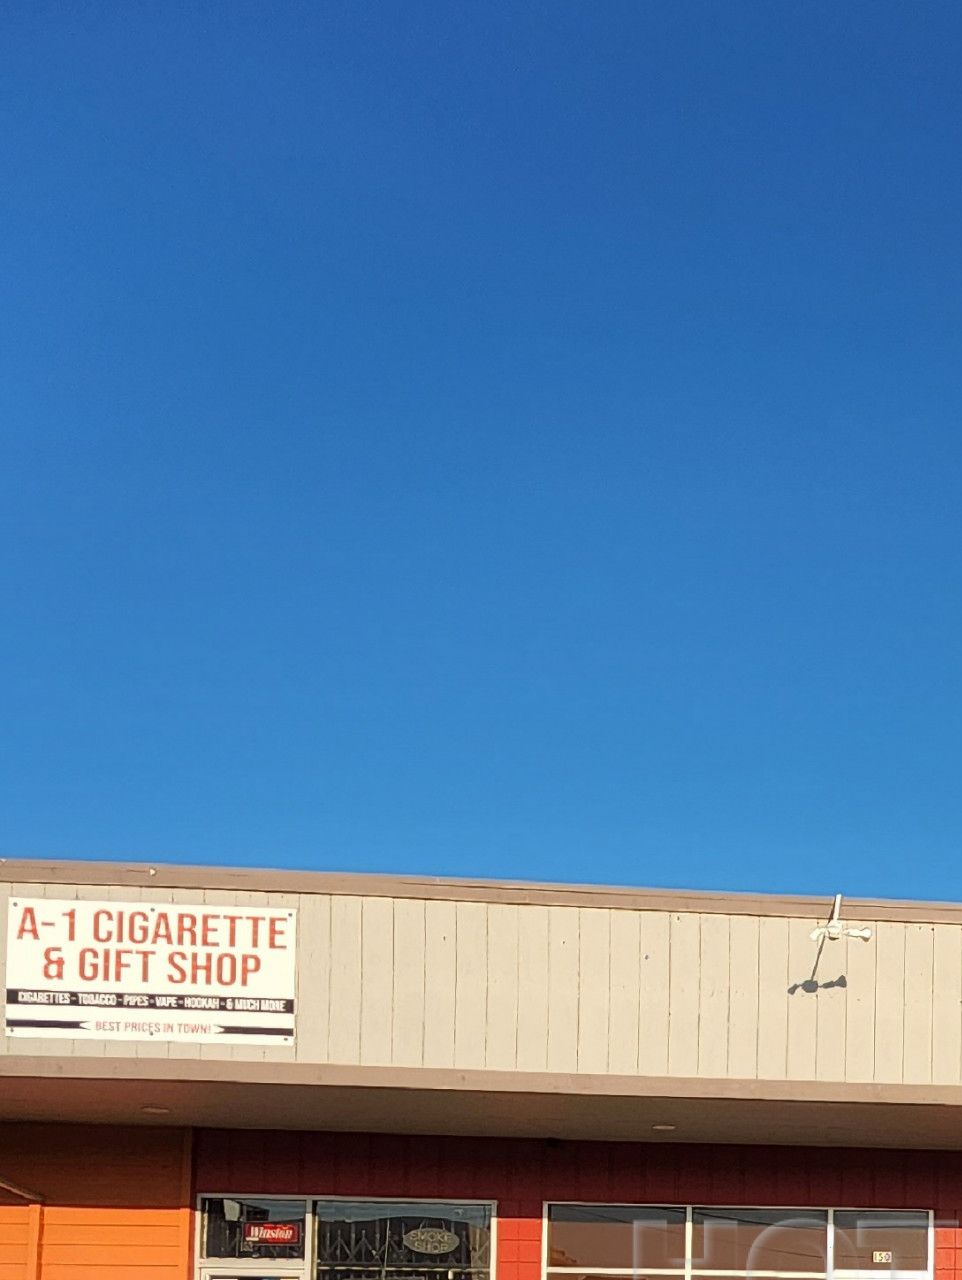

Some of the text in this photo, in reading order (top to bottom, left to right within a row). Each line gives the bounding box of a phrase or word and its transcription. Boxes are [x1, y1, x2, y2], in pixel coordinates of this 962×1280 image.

[16, 907, 288, 950] A-1 CIGARETTE
[42, 946, 262, 987] & GIFT SHOP
[18, 991, 71, 1005] CIGARETTES
[78, 993, 117, 1006] TOBACCO
[123, 994, 149, 1007] PIPES
[155, 996, 178, 1008] VAPE
[184, 996, 220, 1009] HOOKAH
[235, 999, 260, 1011] MUCH
[261, 1000, 287, 1012] MORE
[95, 1020, 121, 1032] BEST
[124, 1021, 161, 1034] PRICES
[163, 1023, 174, 1033] IN
[250, 1225, 293, 1240] Winston
[410, 1231, 452, 1242] SMOKE
[414, 1241, 449, 1251] SHOP
